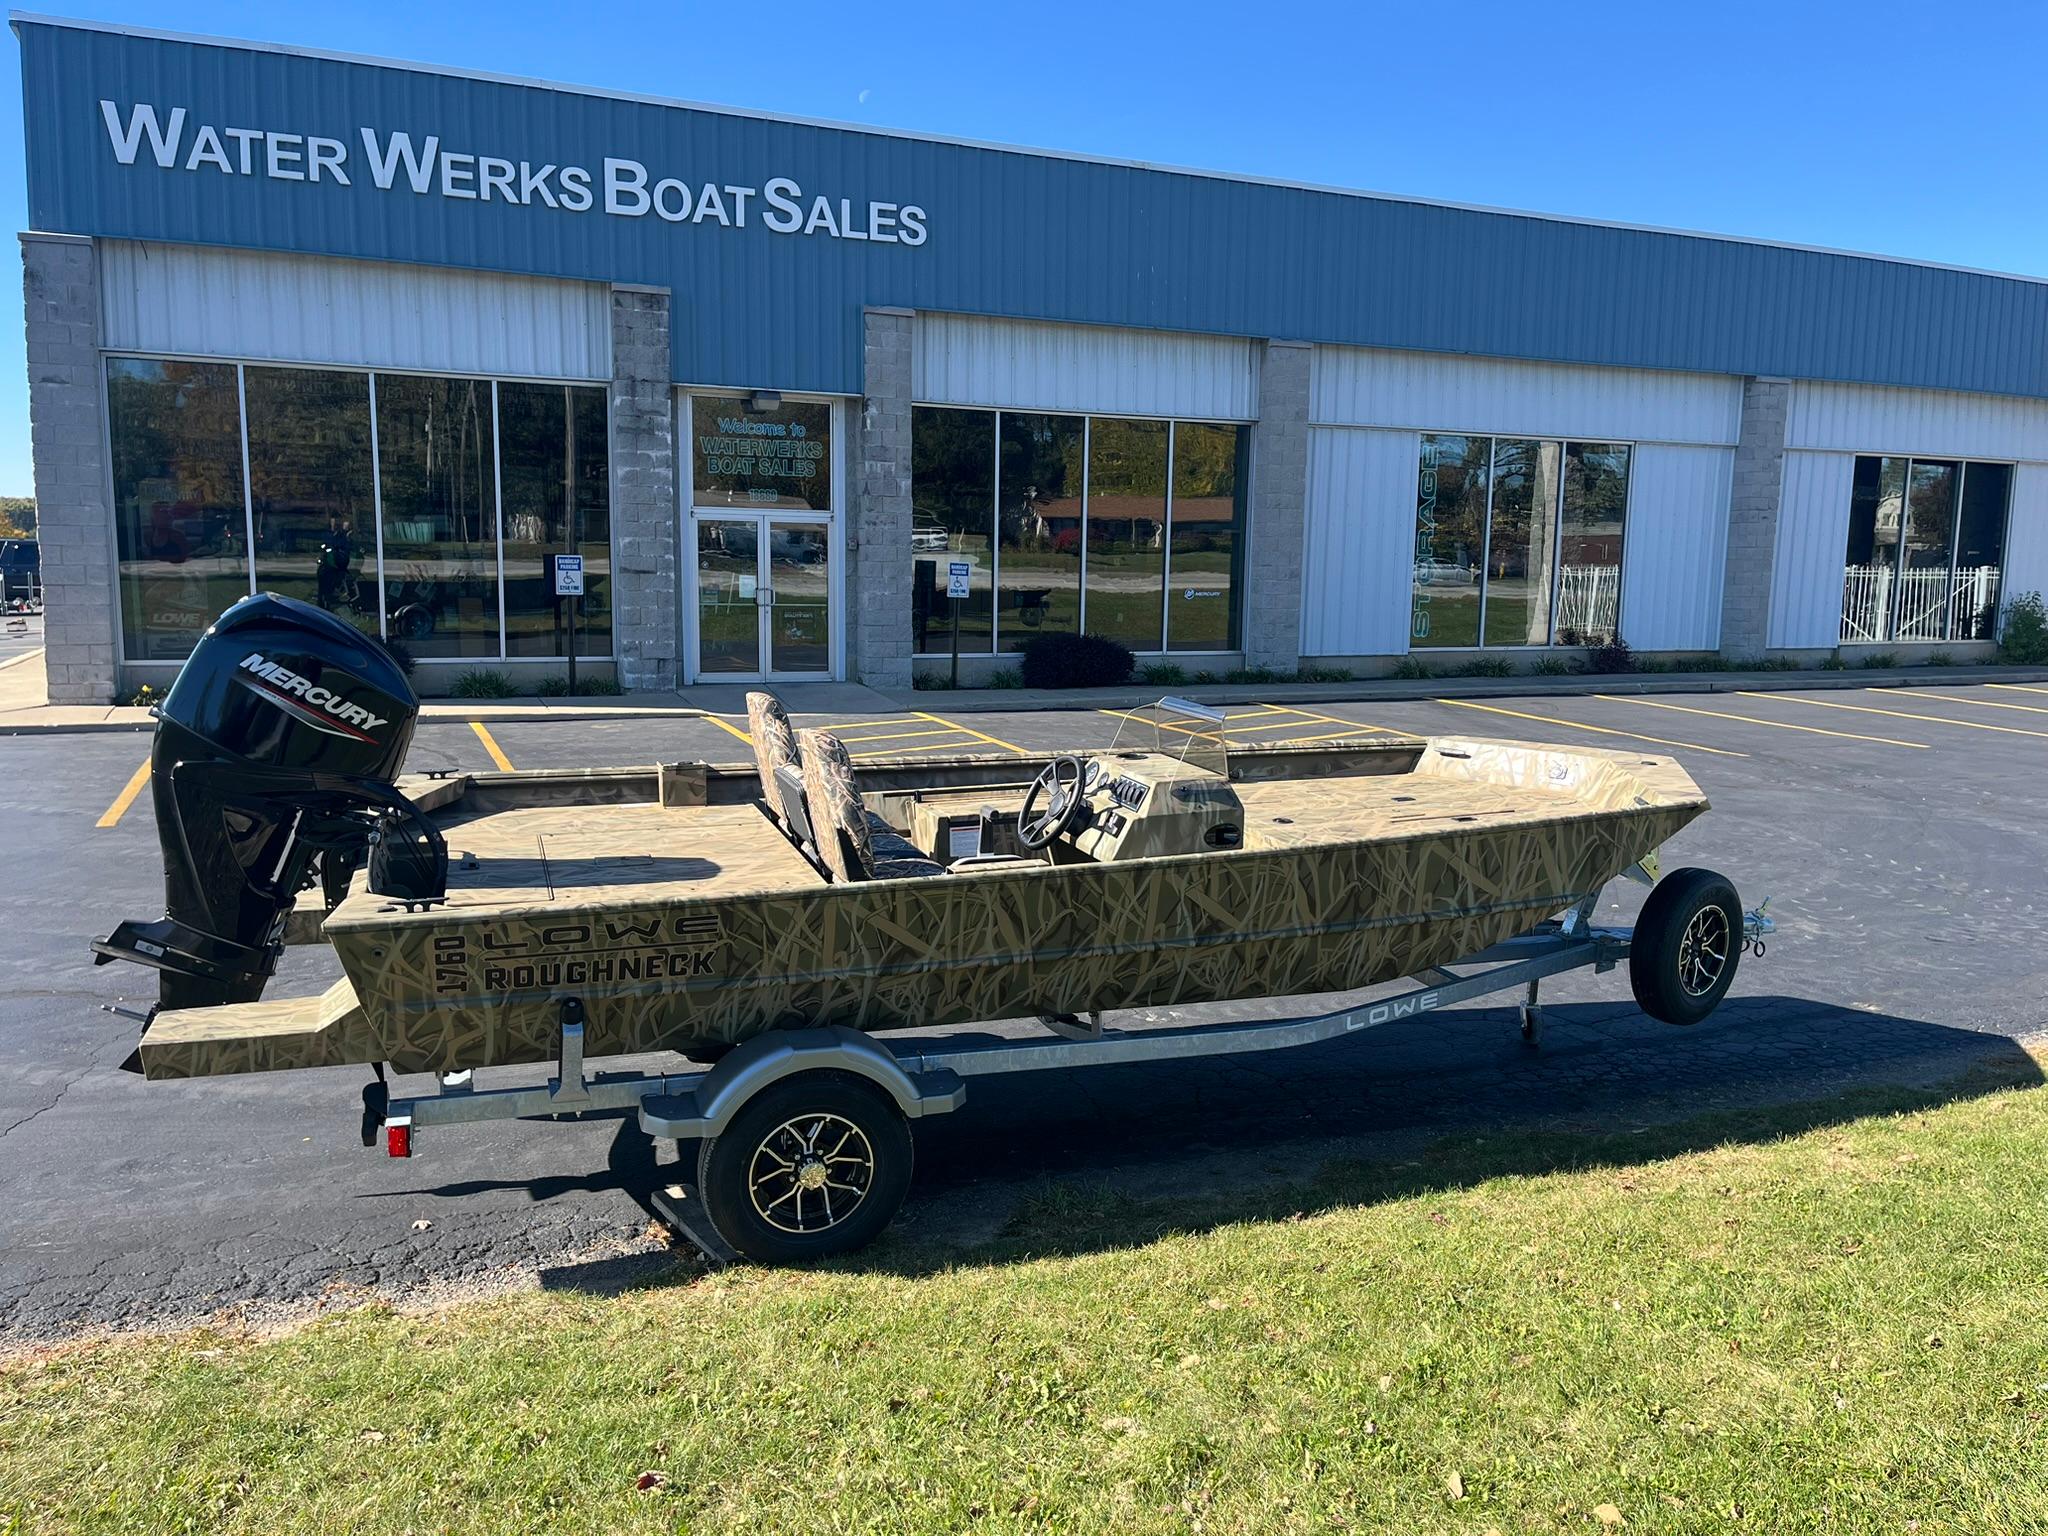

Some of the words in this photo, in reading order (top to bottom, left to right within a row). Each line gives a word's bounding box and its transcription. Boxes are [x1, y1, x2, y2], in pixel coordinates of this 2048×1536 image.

[100, 100, 351, 186] WATER
[360, 127, 593, 212] WERKS
[603, 157, 756, 228] BOAT
[762, 177, 928, 247] SALES
[718, 417, 786, 436] Welcome
[790, 422, 806, 437] to
[700, 436, 823, 459] WATERWERKS
[708, 456, 755, 475] BOAT
[759, 458, 816, 477] SALES
[1413, 444, 1439, 638] STORAGE
[153, 612, 200, 624] LOWE
[239, 653, 388, 730] MERCURY
[483, 915, 720, 950] LOWE
[434, 935, 468, 994] 1760
[484, 951, 716, 991] ROUGHNECK
[1346, 992, 1438, 1030] LOWE
